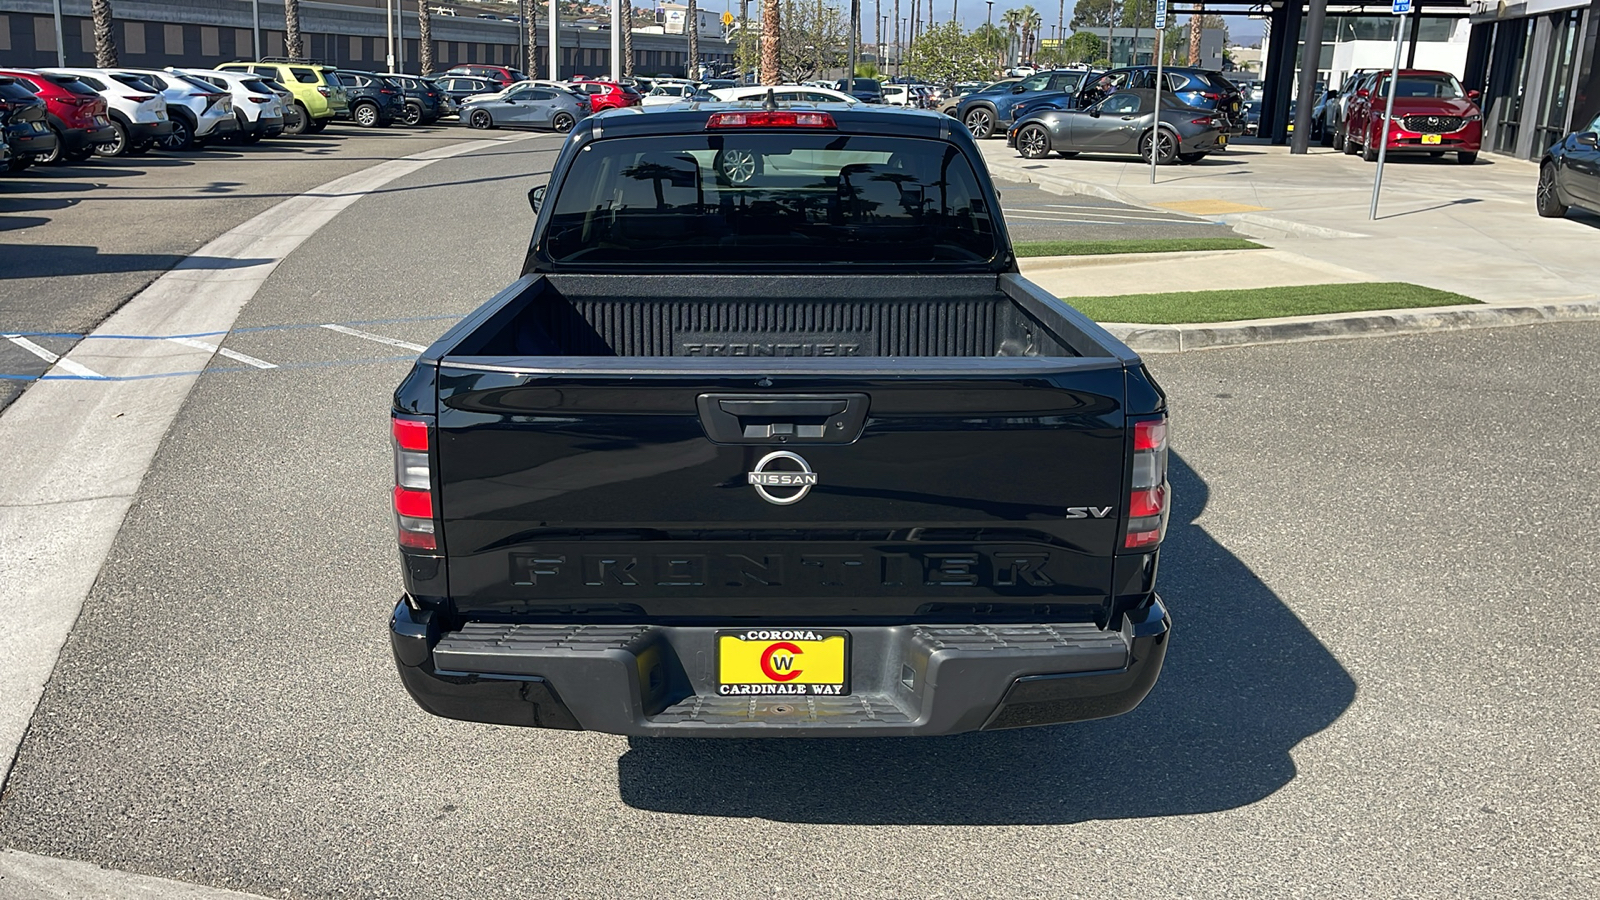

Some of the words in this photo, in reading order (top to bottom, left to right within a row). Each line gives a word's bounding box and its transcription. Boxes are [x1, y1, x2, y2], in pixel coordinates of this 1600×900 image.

[683, 343, 860, 357] FRONTIER
[750, 474, 816, 484] NISSAN
[1066, 506, 1113, 519] SV
[508, 552, 1054, 586] FRONTIER
[747, 630, 816, 640] CORONA
[719, 684, 807, 695] CARDINALE
[811, 684, 843, 695] WAY
